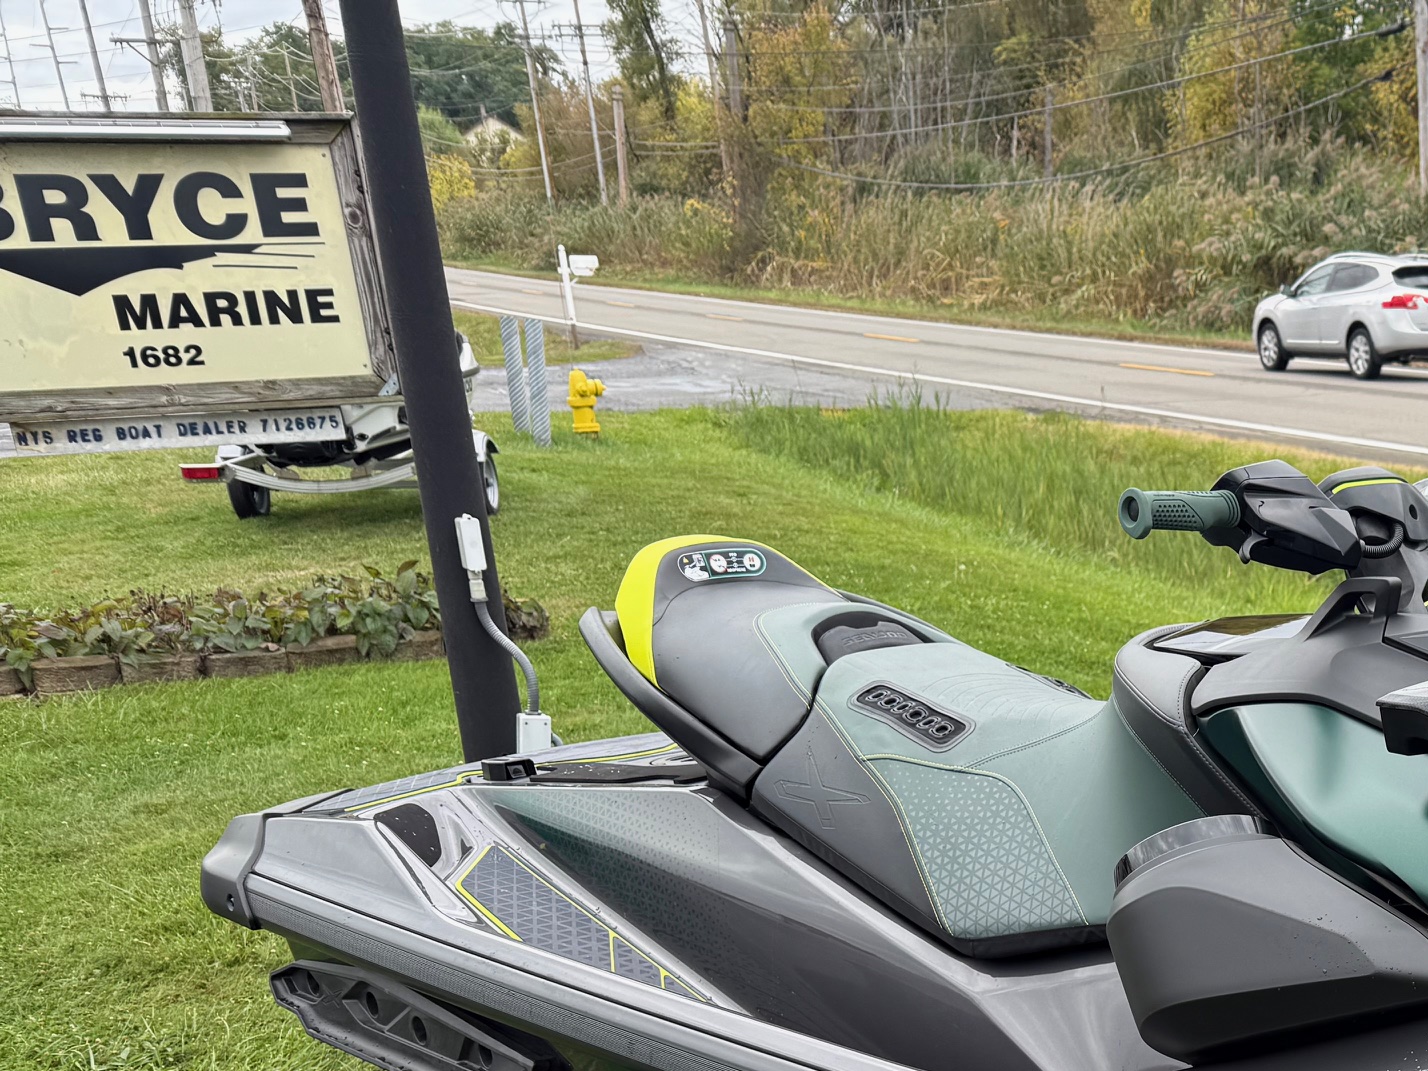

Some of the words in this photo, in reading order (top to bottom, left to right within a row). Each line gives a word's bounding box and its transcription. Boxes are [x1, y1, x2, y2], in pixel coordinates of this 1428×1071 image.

[0, 171, 320, 242] RYCE
[112, 288, 340, 331] MARINE
[122, 344, 206, 369] 1682
[16, 431, 54, 447] NYS
[68, 427, 103, 443] REG
[116, 424, 163, 440] BOAT
[177, 418, 248, 437] DEALER
[259, 415, 340, 432] 7126675
